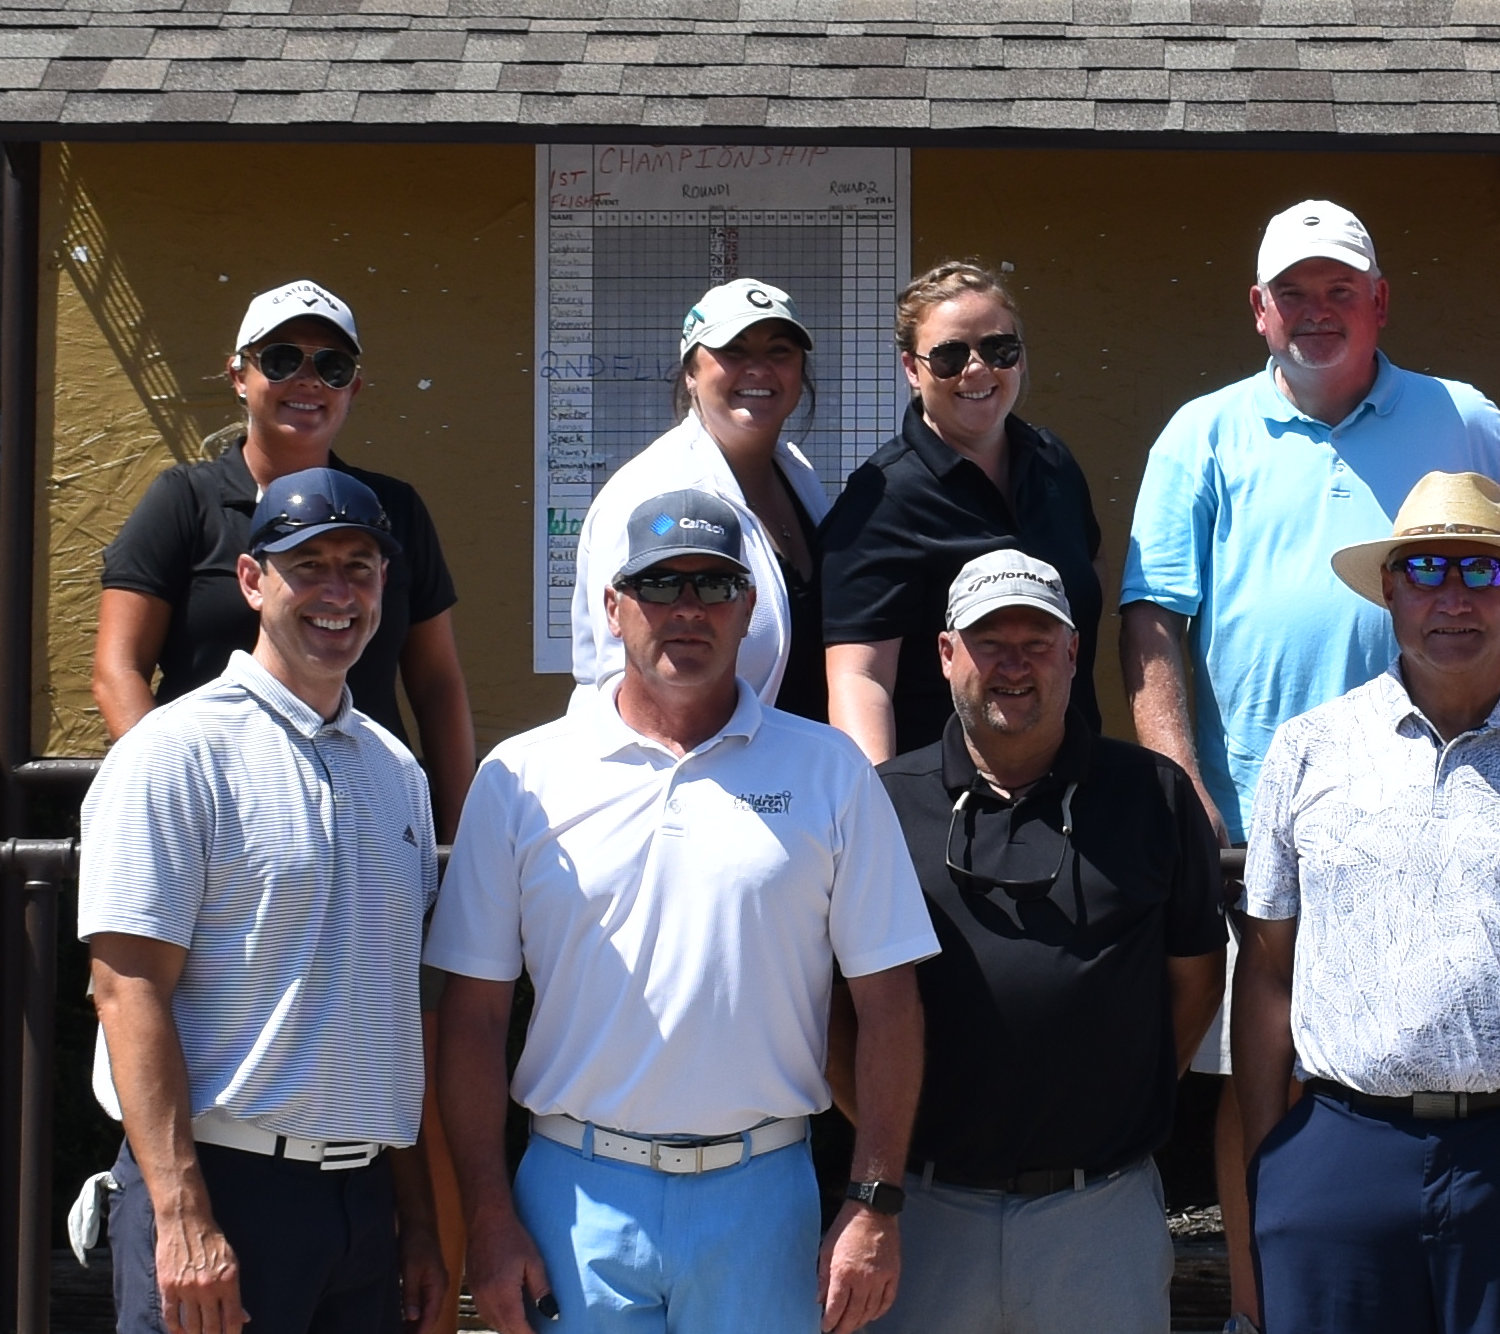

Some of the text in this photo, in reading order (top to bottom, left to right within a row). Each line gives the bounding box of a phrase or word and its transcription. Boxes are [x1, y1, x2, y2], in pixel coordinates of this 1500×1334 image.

[550, 170, 587, 189] 1ST
[550, 213, 574, 221] NAME
[539, 350, 606, 379] 2ND
[550, 433, 585, 444] Speck
[679, 517, 725, 536] CalTech
